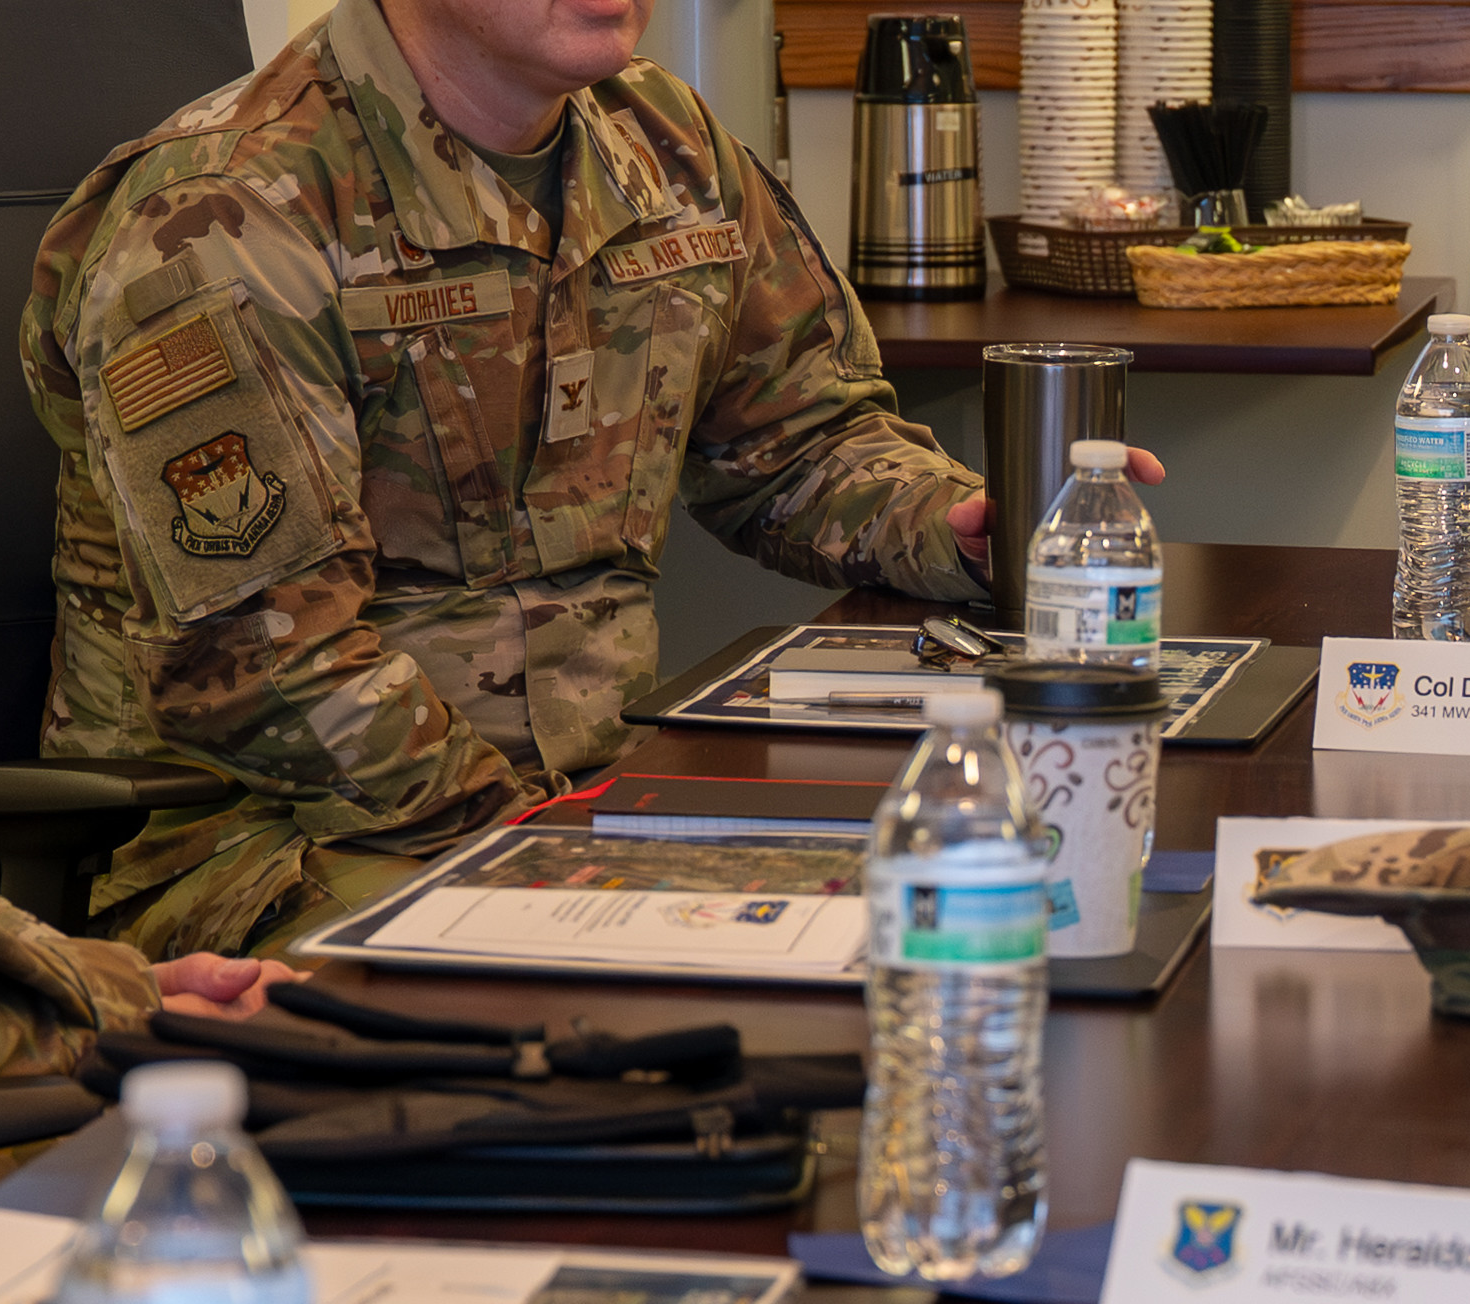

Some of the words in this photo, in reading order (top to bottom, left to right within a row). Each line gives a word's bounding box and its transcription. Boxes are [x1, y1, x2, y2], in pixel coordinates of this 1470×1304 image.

[924, 169, 963, 184] WATER
[606, 246, 651, 280] U.S.
[649, 237, 689, 272] AIR
[685, 227, 743, 262] FORCE
[385, 282, 479, 326] VOORHIES
[1419, 437, 1444, 446] WATER
[1414, 675, 1454, 698] Col
[1411, 705, 1437, 718] 341
